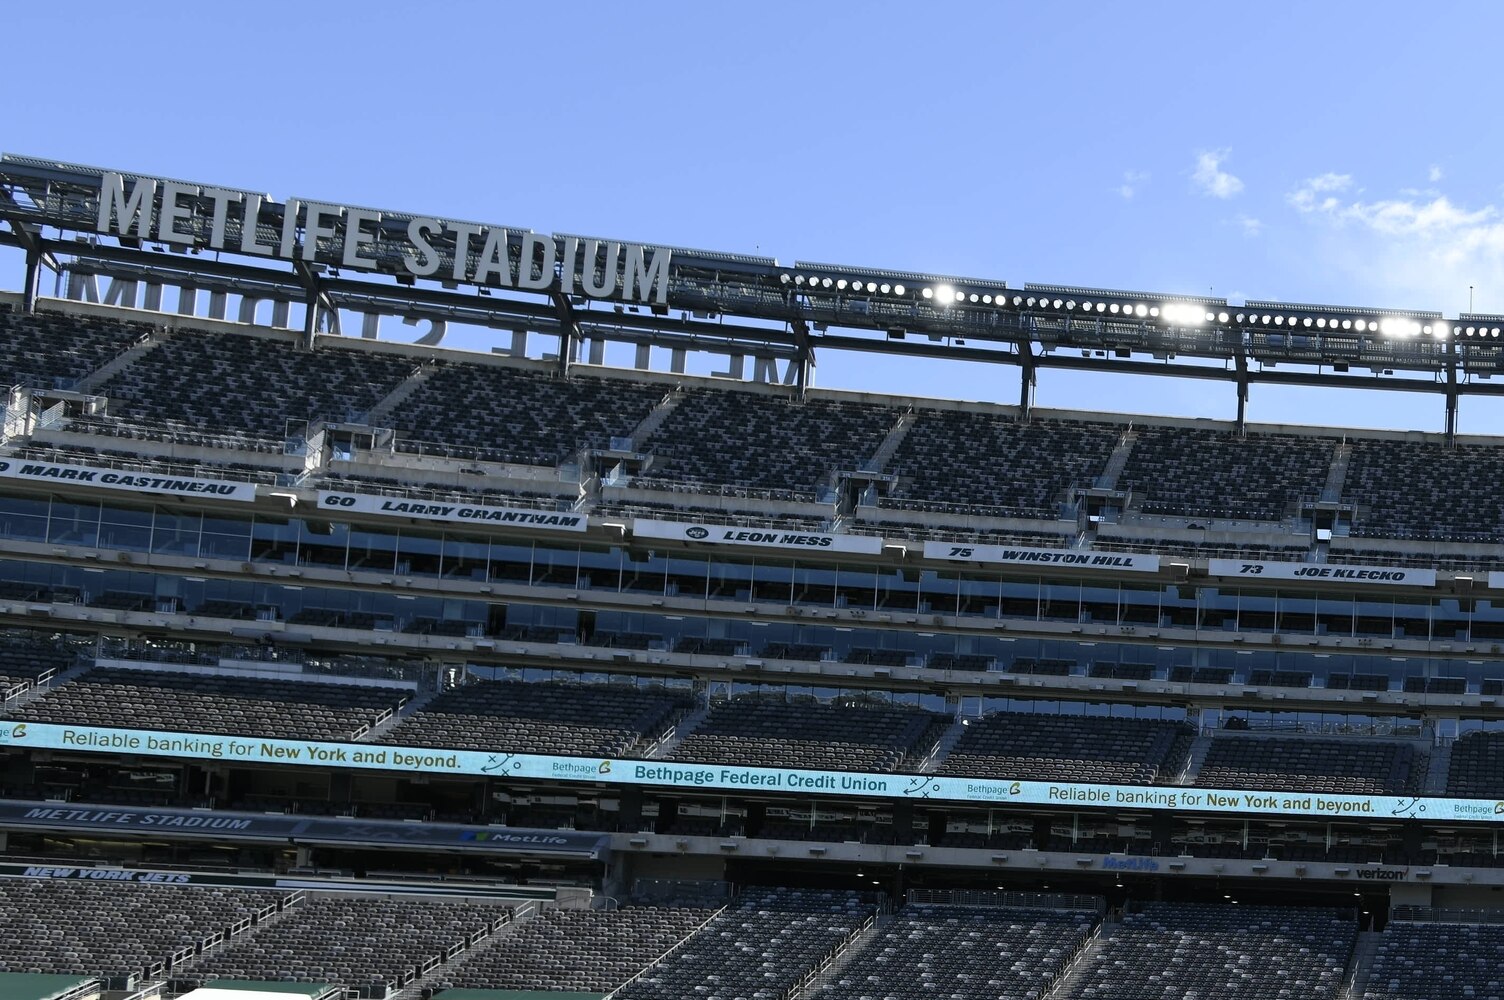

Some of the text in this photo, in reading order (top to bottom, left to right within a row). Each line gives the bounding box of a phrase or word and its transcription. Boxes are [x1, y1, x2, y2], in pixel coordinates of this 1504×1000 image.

[97, 172, 672, 303] METLIFE STADIUM
[19, 464, 98, 482] MARK
[100, 473, 236, 495] GASTINEAU
[324, 495, 580, 527] 60 LARRY GRANTHAM
[723, 530, 780, 543] LEON
[780, 535, 833, 547] HESS
[948, 547, 1133, 567] 75 WINSTON HILL
[1239, 564, 1405, 581] 73 JOE KLECKO
[62, 730, 461, 769] Reliable banking for New York and beyond.
[552, 762, 597, 774] Bethpage
[634, 765, 887, 791] Bethpage Federal Credit Union
[967, 784, 1008, 795] Bethpage
[1049, 786, 1375, 814] Reliable banking for New York and beyond.
[1454, 804, 1493, 815] Bethpage
[24, 808, 252, 830] METLIFE STADIUM
[492, 834, 567, 844] MetLife
[1103, 856, 1159, 871] MetLife
[23, 867, 192, 884] NEW YORK JETS
[1357, 866, 1404, 880] verizon
